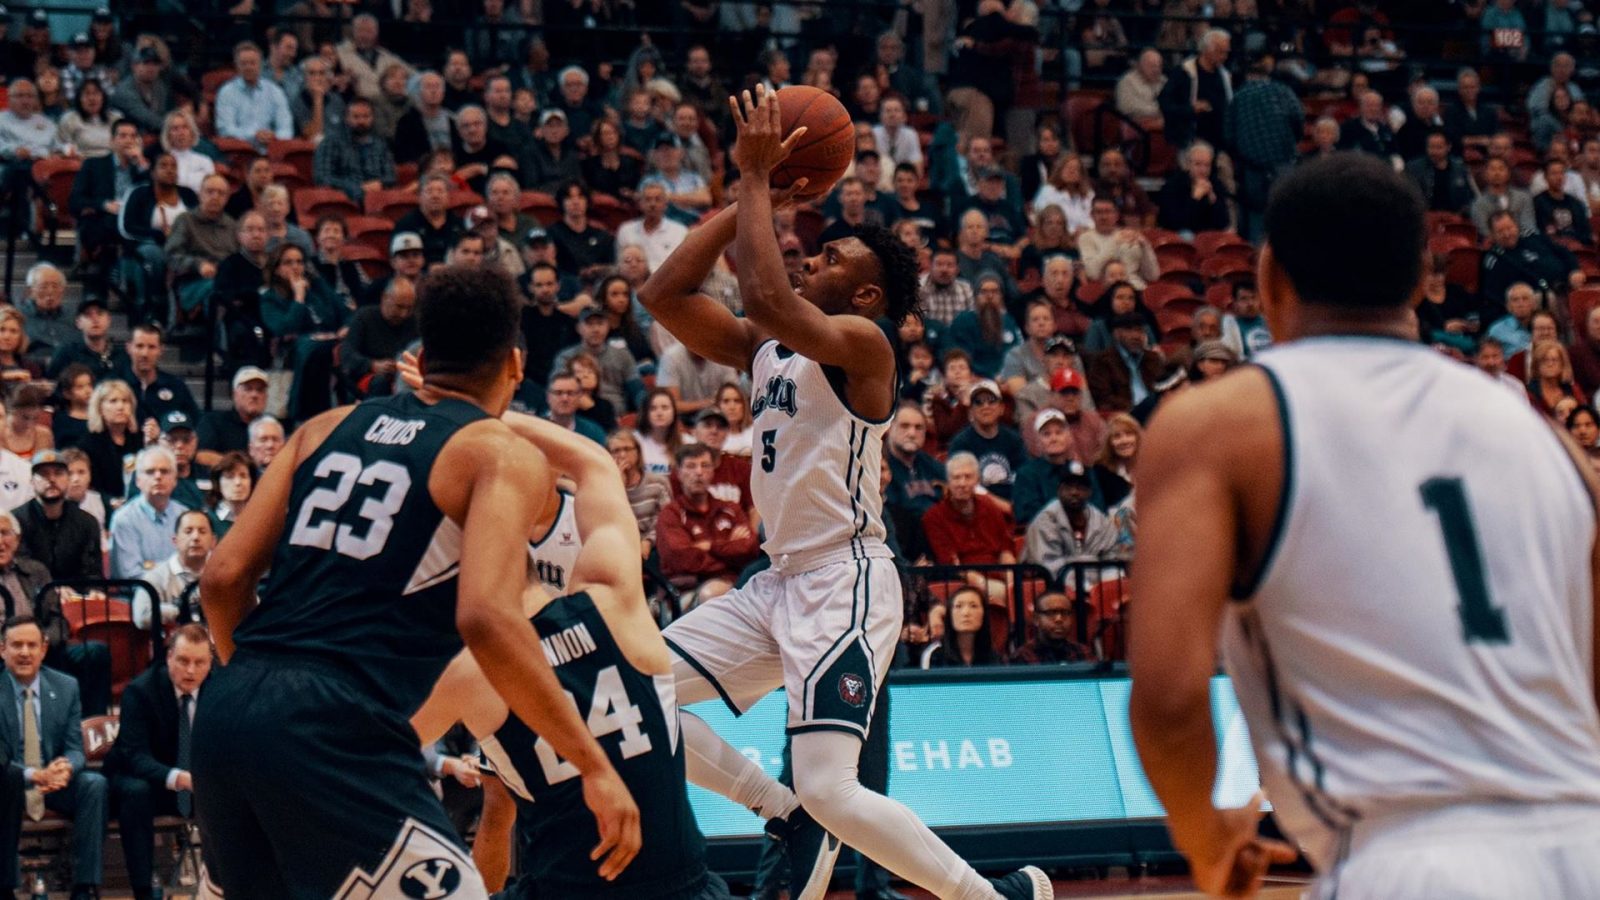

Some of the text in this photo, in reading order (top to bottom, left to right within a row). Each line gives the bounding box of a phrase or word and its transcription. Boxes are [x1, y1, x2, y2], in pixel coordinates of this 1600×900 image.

[364, 414, 426, 445] CHILDS
[761, 429, 777, 473] 5
[289, 452, 411, 561] 23
[1418, 475, 1512, 646] 1
[540, 622, 597, 667] NNON
[88, 721, 120, 752] LM
[894, 738, 1013, 772] EHAB
[405, 860, 453, 899] Y
